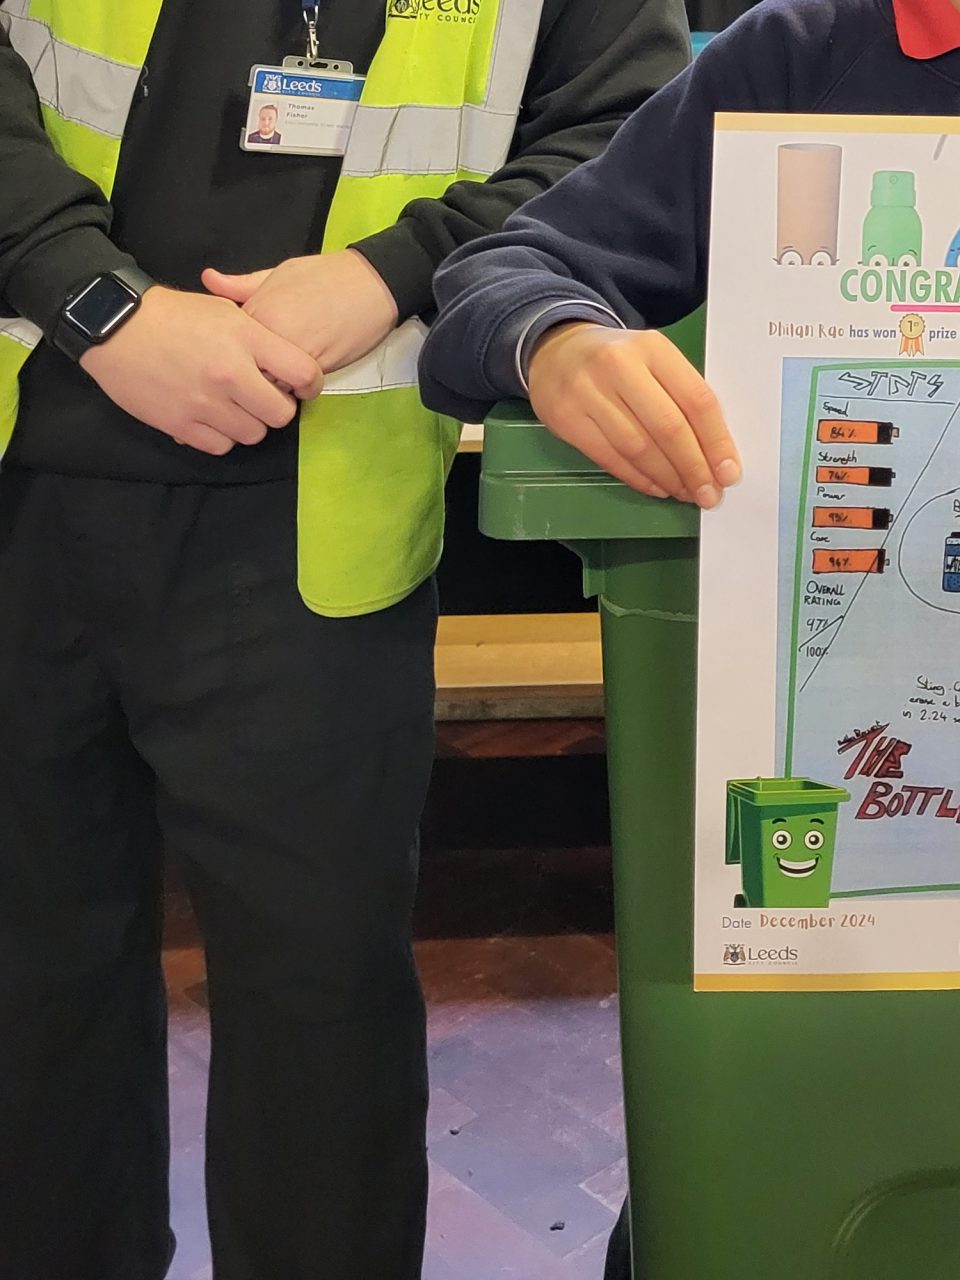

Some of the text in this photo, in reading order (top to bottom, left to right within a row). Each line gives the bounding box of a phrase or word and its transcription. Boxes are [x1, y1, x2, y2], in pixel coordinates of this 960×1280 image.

[282, 78, 323, 93] Leeds
[818, 323, 845, 339] Rao
[849, 325, 870, 338] has
[873, 327, 897, 339] won
[929, 326, 957, 342] prize
[823, 401, 849, 418] Speed
[722, 914, 876, 929] Date December 2024
[748, 946, 798, 960] Leeds
